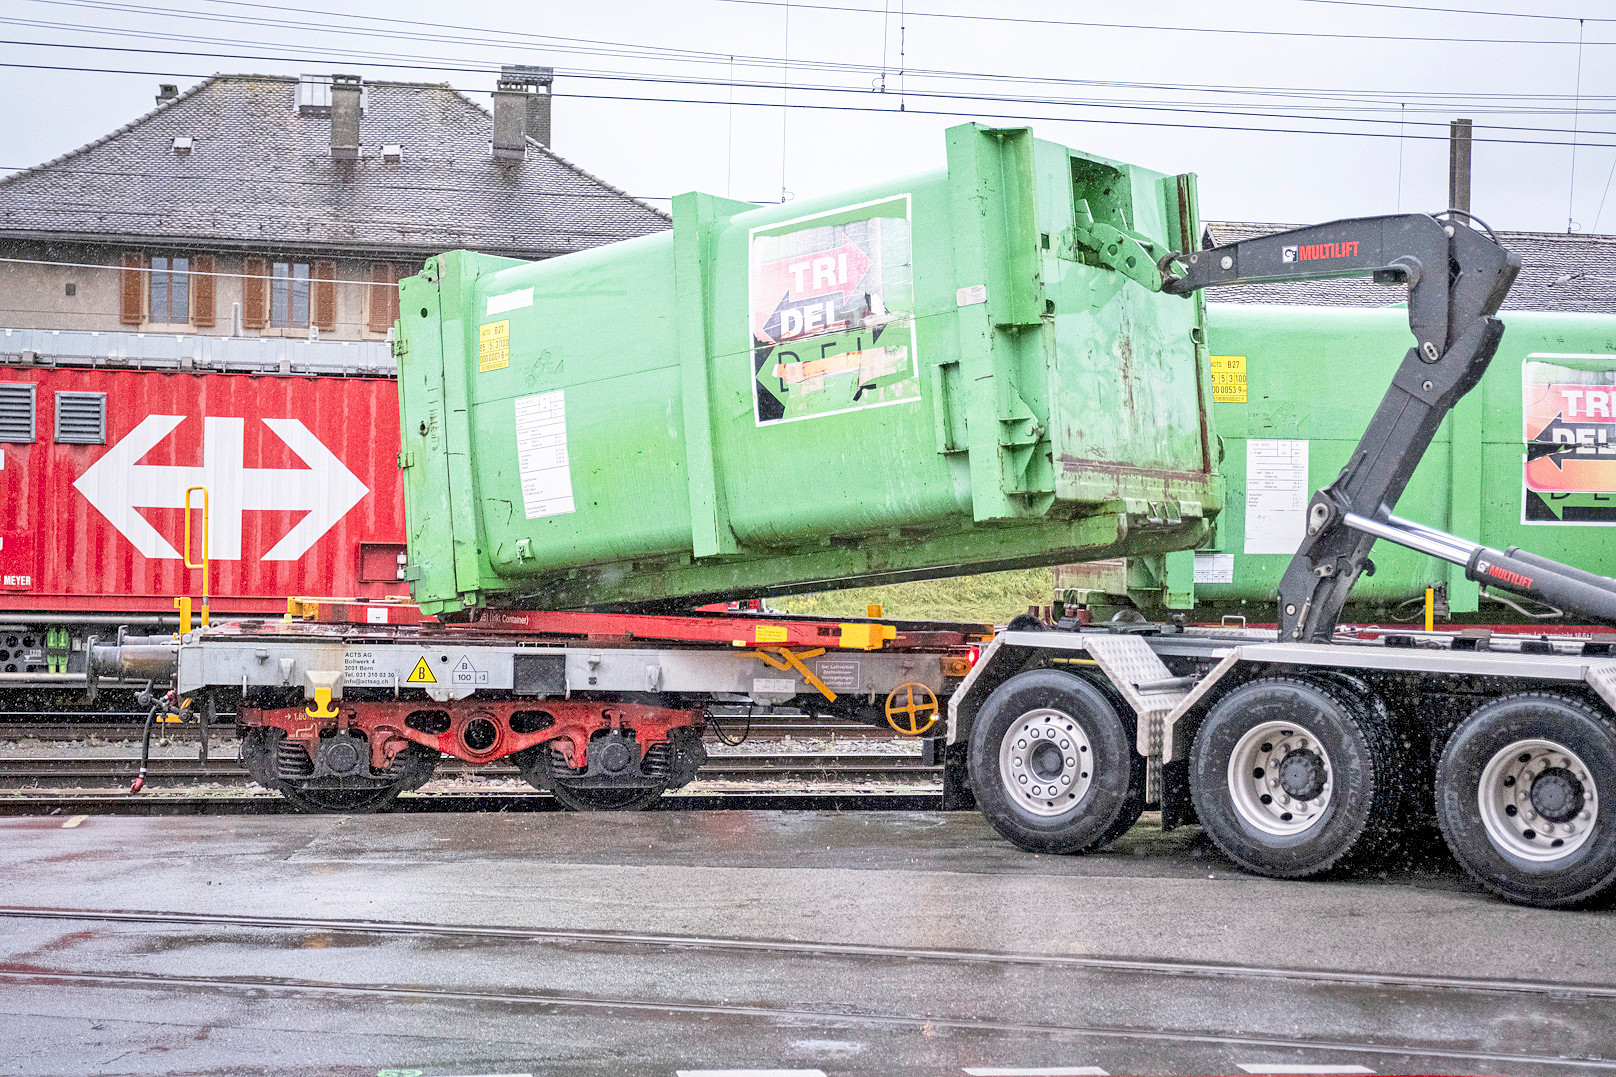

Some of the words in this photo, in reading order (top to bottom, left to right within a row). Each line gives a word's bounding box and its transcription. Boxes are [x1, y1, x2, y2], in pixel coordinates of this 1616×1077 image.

[1299, 241, 1360, 261] MULTILIFT
[788, 252, 848, 294] TRI
[780, 300, 846, 339] DEL
[494, 324, 505, 335] B27
[1227, 360, 1240, 369] B27
[1235, 374, 1247, 383] 100
[3, 575, 31, 586] MEYER
[1488, 564, 1534, 590] MULTILIFT
[461, 662, 468, 670] B
[418, 666, 426, 680] B
[343, 678, 389, 686] info@actsag.ch
